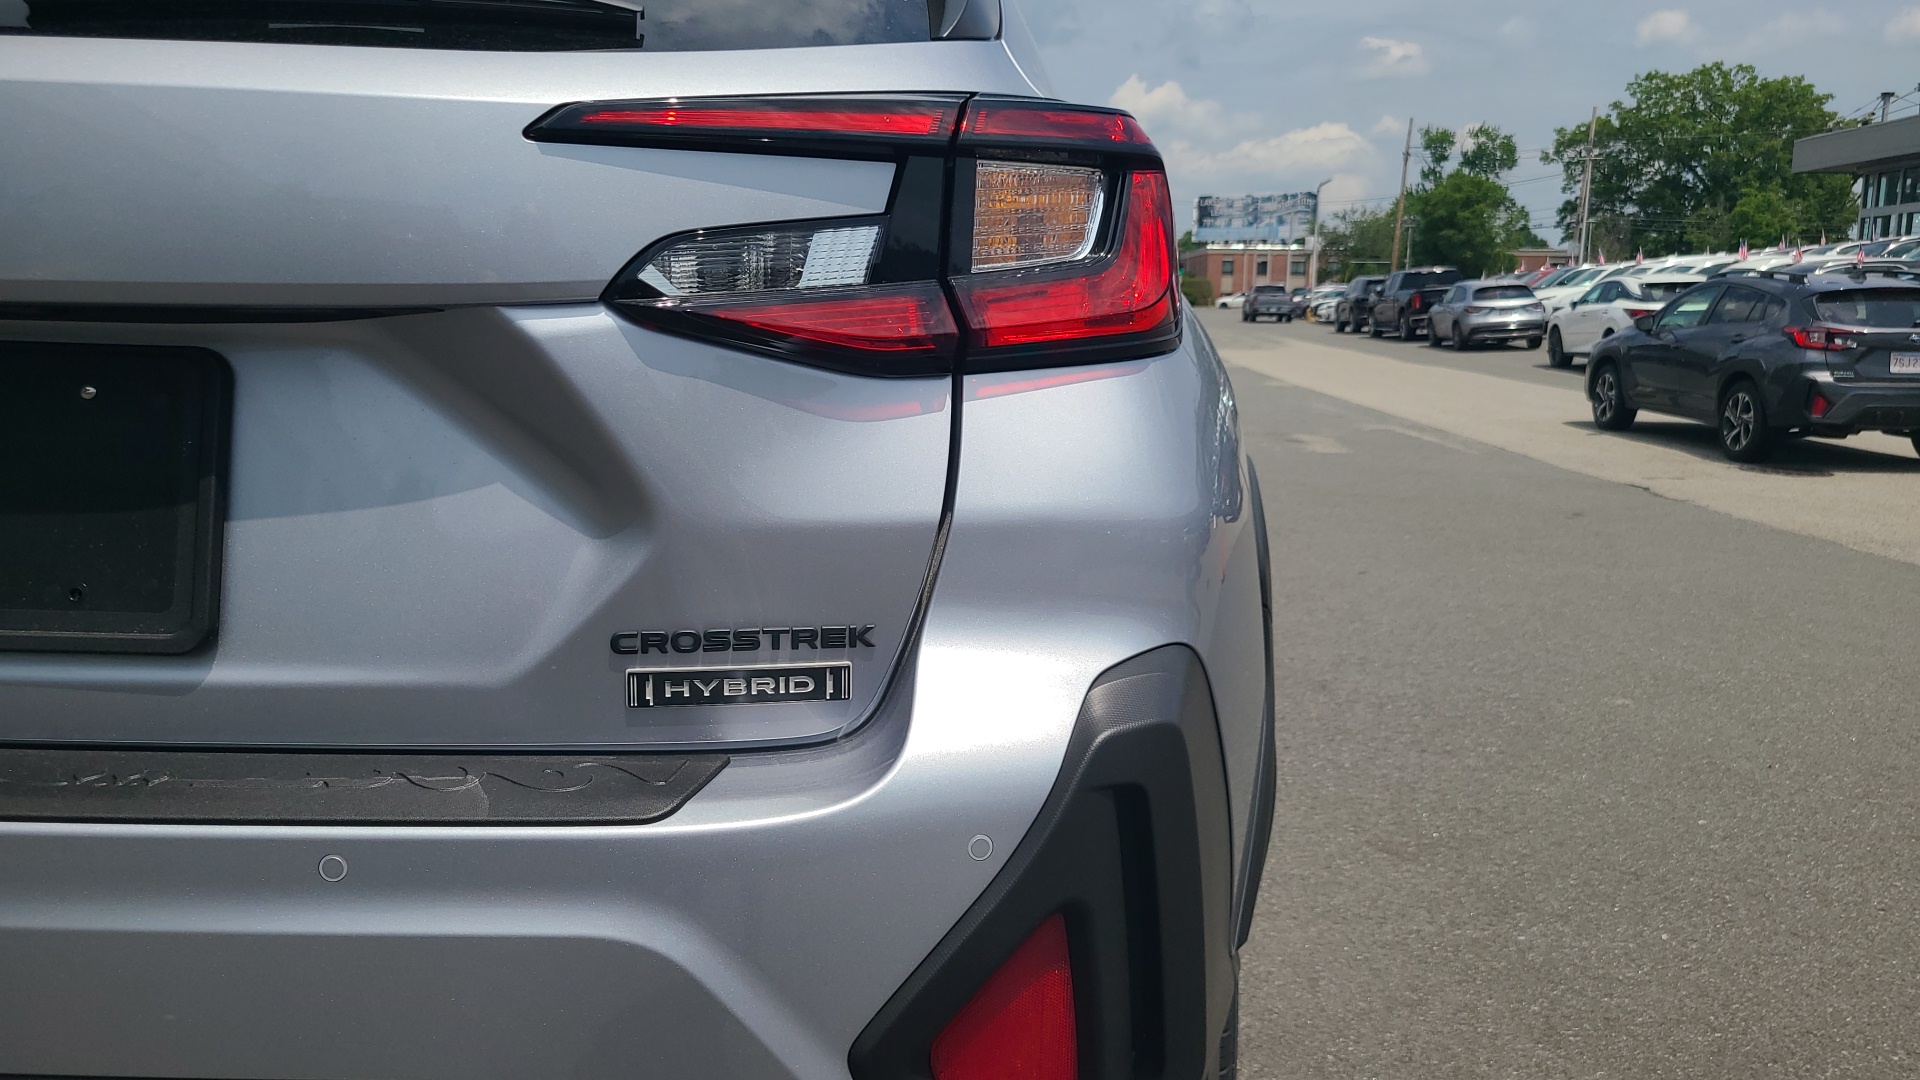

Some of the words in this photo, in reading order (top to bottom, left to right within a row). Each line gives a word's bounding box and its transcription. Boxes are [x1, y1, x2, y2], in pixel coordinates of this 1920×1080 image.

[1893, 358, 1920, 368] 7SJ2
[610, 624, 876, 655] CROSSTREK
[664, 675, 816, 698] HYBRID
